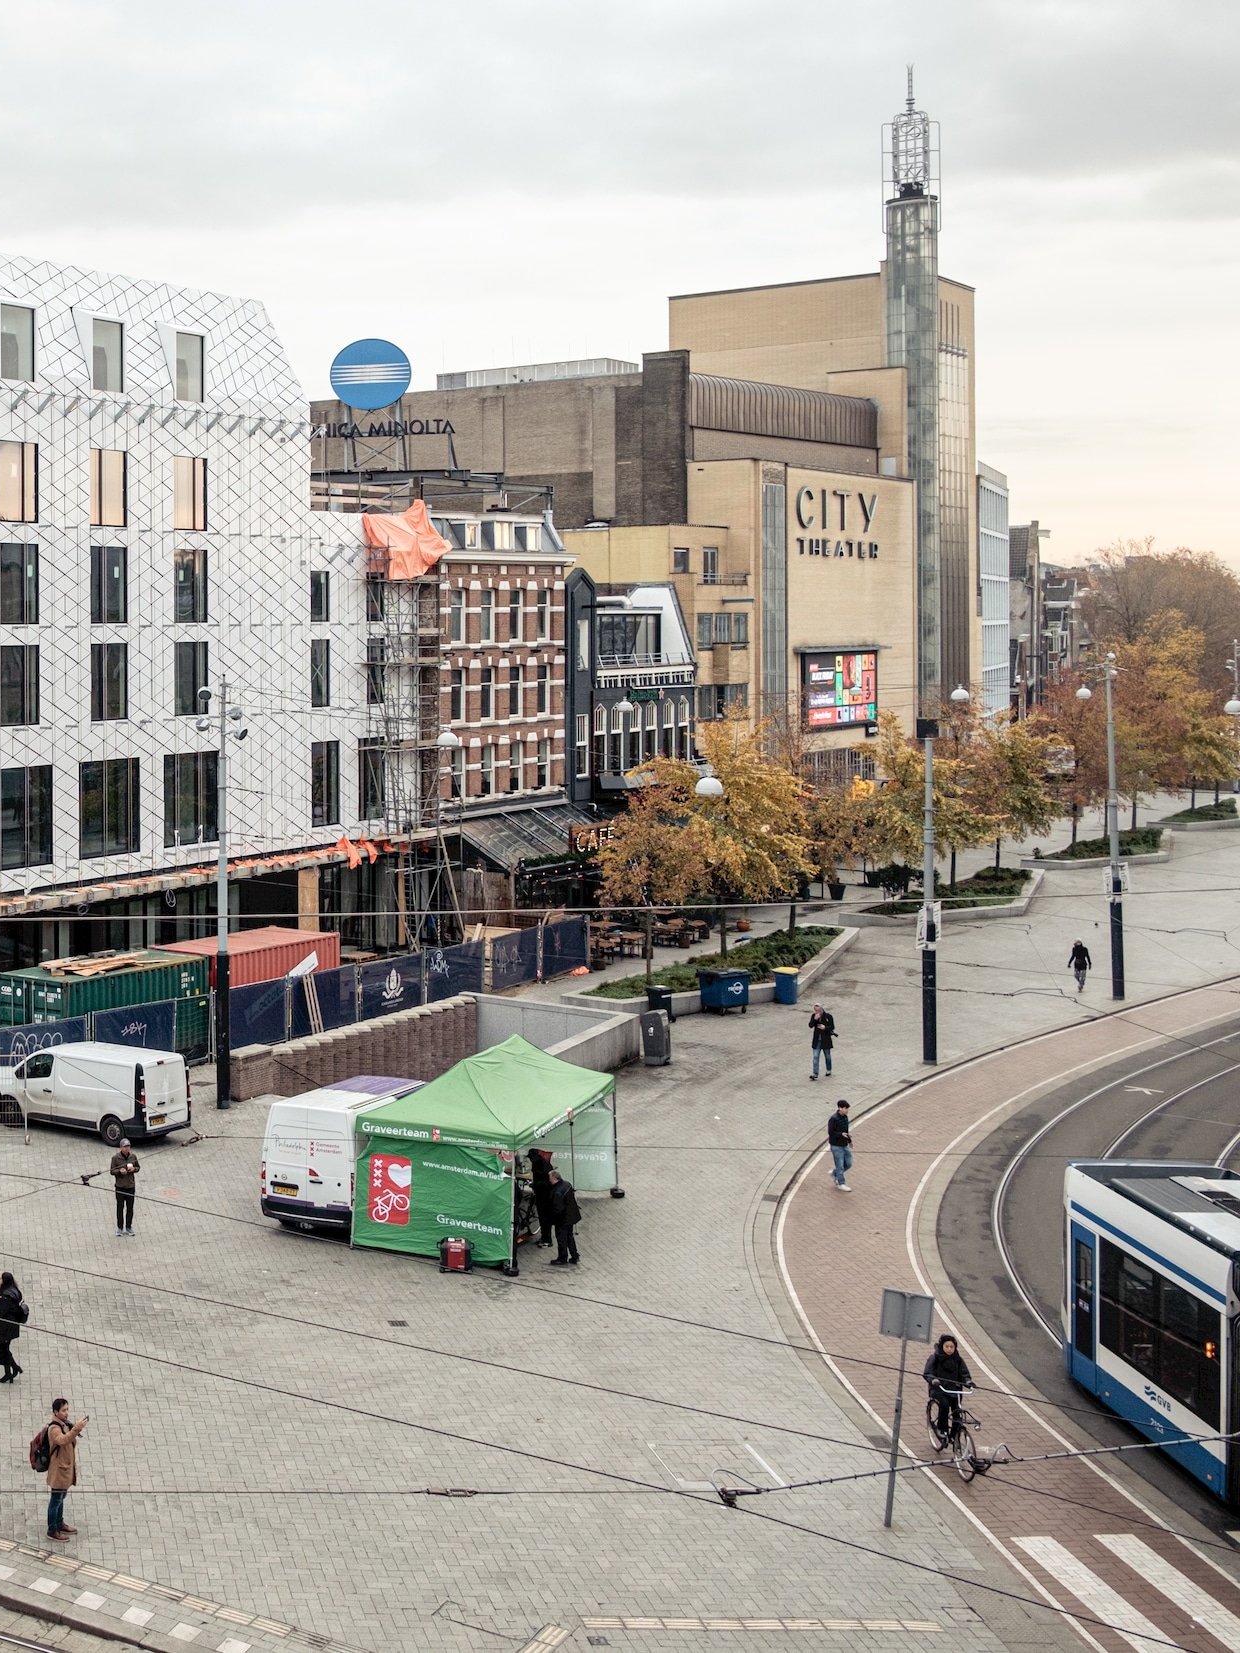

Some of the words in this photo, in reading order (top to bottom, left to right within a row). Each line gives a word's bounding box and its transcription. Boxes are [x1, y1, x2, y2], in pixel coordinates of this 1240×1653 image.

[368, 419, 456, 437] MINOLTA
[796, 486, 878, 533] CITY
[796, 537, 879, 559] THEATER
[362, 1122, 429, 1138] Graveerteam
[436, 1214, 503, 1235] Graveerteam
[1157, 1395, 1172, 1412] GVB
